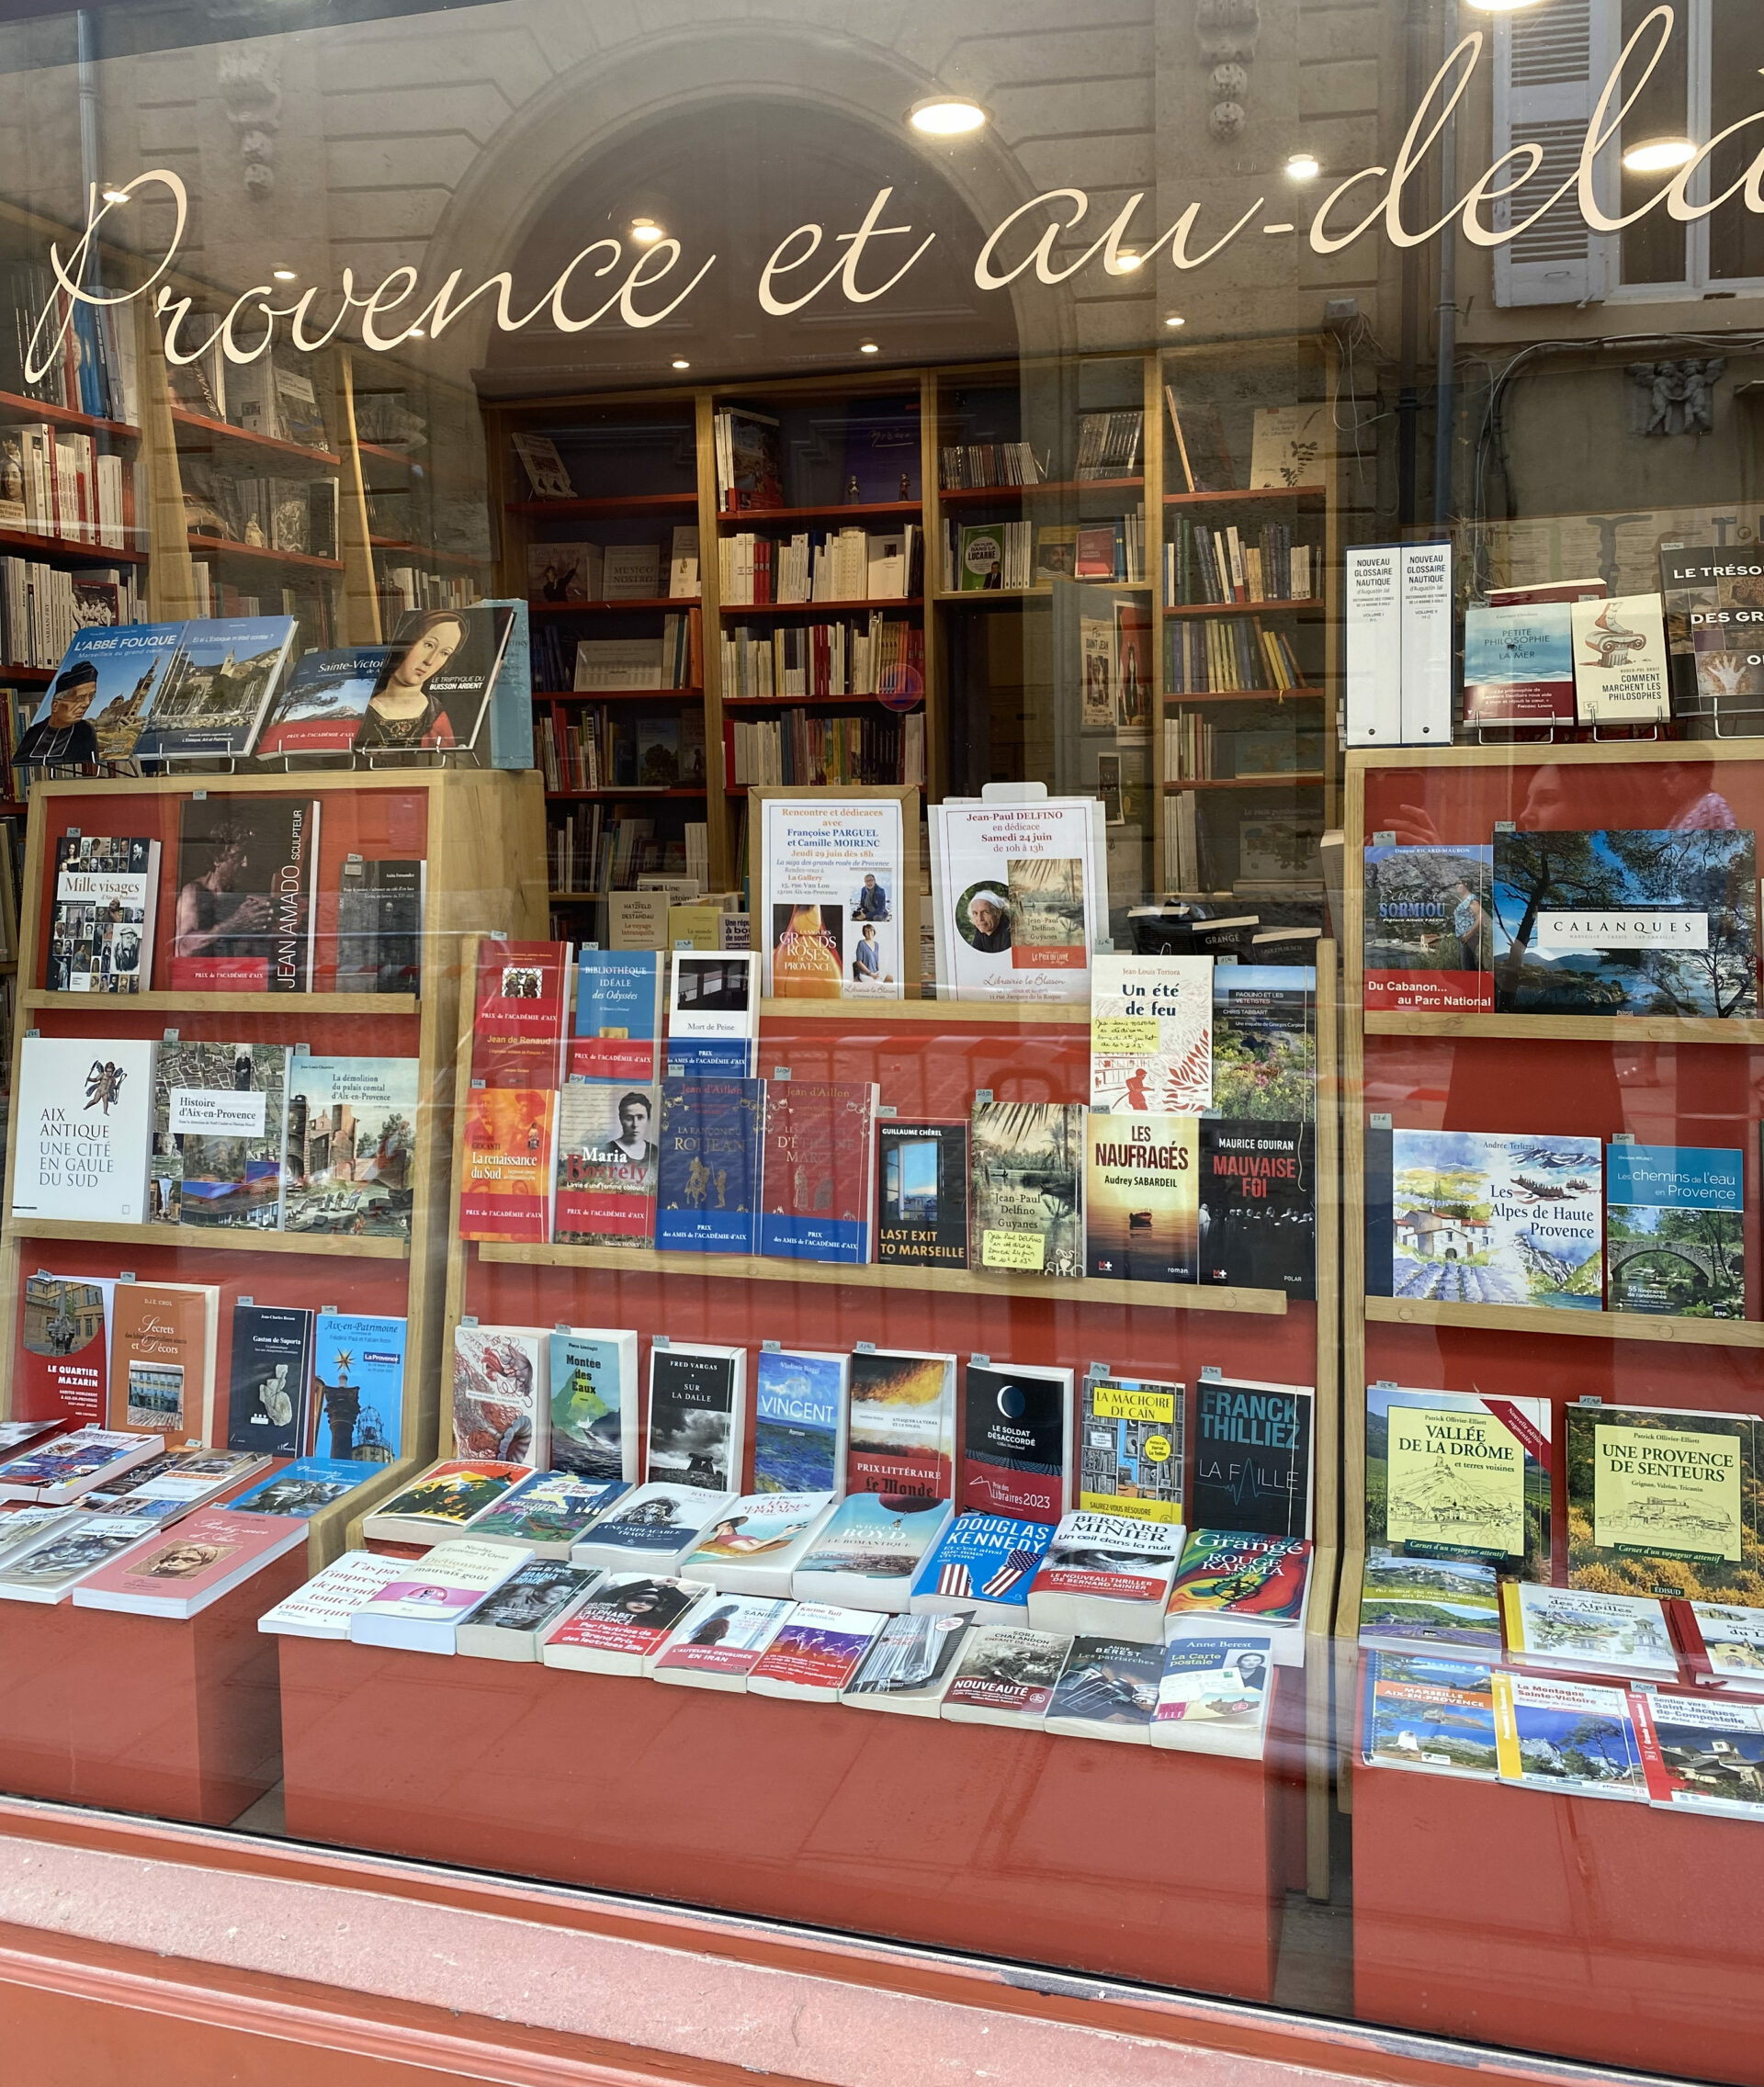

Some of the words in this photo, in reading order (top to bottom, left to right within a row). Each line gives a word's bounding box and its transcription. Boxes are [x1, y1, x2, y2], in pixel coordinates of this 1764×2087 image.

[24, 168, 717, 384] Provence
[757, 189, 935, 317] et
[1409, 555, 1443, 563] NOUVEAU
[1354, 568, 1392, 576] GLOSSAIRE
[1408, 565, 1445, 573] GLOSSAIRE
[1674, 568, 1696, 579] LE
[1701, 564, 1764, 577] TRÉSO
[1356, 578, 1391, 586] NAUTIQUE
[1409, 575, 1443, 583] NAUTIQUE
[1691, 612, 1730, 625] DES
[1502, 628, 1532, 637] PETITE
[74, 637, 119, 651] L'ABBÉ
[120, 635, 176, 648] FOUQUE
[1485, 635, 1550, 645] PHILOSOPHIE
[1622, 673, 1659, 683] COMMENT
[1602, 683, 1645, 693] MARCHENT
[1647, 683, 1661, 691] LES
[1609, 692, 1661, 701] PHILOSOPHES
[967, 812, 1014, 822] Jean-Paul
[1016, 812, 1063, 820] DELFINO
[291, 810, 302, 860] SCULPTEUR
[787, 829, 831, 838] Françoise
[981, 834, 1016, 842] Samedi
[1033, 833, 1052, 843] juin
[279, 865, 300, 937] AMADO
[1380, 901, 1445, 919] SORMIOU
[1554, 921, 1691, 934] CALANQUES
[277, 942, 296, 988] JEAN
[585, 966, 647, 977] BIBLIOTHÈQUE
[600, 978, 631, 987] IDÉALE
[1368, 982, 1384, 991] Du
[1386, 981, 1447, 993] Cabanon...
[593, 991, 604, 999] des
[606, 991, 638, 1002] Odyssées
[1123, 985, 1145, 996] Un
[1153, 983, 1180, 998] été
[1397, 997, 1413, 1005] au
[1416, 995, 1440, 1006] Parc
[1443, 995, 1491, 1007] National
[1125, 1001, 1144, 1016] de
[1152, 1001, 1176, 1016] feu
[687, 1022, 707, 1031] Mort
[179, 1097, 215, 1108] Histoire
[40, 1109, 65, 1122] AIX
[40, 1123, 109, 1140] ANTIQUE
[1132, 1125, 1151, 1142] LES
[40, 1143, 71, 1156] UNE
[76, 1141, 110, 1157] CITÉ
[1219, 1138, 1255, 1149] MAURICE
[1258, 1139, 1294, 1150] GOUIRAN
[472, 1152, 482, 1164] La
[484, 1154, 537, 1166] renaissance
[583, 1147, 628, 1163] Maria
[1095, 1141, 1188, 1170] NAUFRAGÉS
[40, 1157, 64, 1170] EN
[68, 1158, 113, 1172] GAULE
[1214, 1156, 1295, 1179] MAUVAISE
[40, 1173, 62, 1185] DU
[67, 1174, 98, 1187] SUD
[471, 1168, 482, 1179] du
[484, 1168, 501, 1179] Sud
[1104, 1175, 1132, 1187] Audrey
[1134, 1177, 1177, 1188] SABARDEIL
[1242, 1178, 1266, 1198] FOI
[994, 1193, 1041, 1204] Jean-Paul
[1490, 1184, 1513, 1199] Les
[1656, 1189, 1666, 1197] en
[1668, 1185, 1736, 1200] Provence
[1001, 1204, 1035, 1215] Delfino
[1491, 1203, 1529, 1219] Alpes
[1532, 1207, 1550, 1219] de
[1554, 1208, 1594, 1222] Haute
[881, 1230, 908, 1240] LAST
[911, 1230, 937, 1242] EXIT
[1531, 1223, 1595, 1239] Provence
[881, 1244, 896, 1255] TO
[899, 1245, 965, 1258] MARSEILLE
[138, 1315, 175, 1334] Secrets
[325, 1321, 398, 1333] Aix-en-Patrimoine
[253, 1336, 270, 1344] Gaston
[566, 1354, 601, 1370] Montée
[691, 1362, 718, 1371] VARGAS
[59, 1365, 98, 1377] QUARTIER
[574, 1369, 593, 1381] des
[58, 1377, 98, 1387] MAZARIN
[572, 1382, 596, 1394] Eaux
[684, 1383, 700, 1392] SUR
[673, 1392, 683, 1400] LA
[685, 1393, 712, 1403] DALLE
[1096, 1392, 1109, 1402] LA
[1112, 1392, 1170, 1408] MÂCHOIRE
[761, 1395, 833, 1423] VINCENT
[1111, 1406, 1126, 1417] DE
[1129, 1406, 1155, 1419] CAÏN
[1204, 1390, 1301, 1423] FRANCK
[988, 1432, 1036, 1446] DÉSACCORDÉ
[1002, 1427, 1030, 1437] SOLDAT
[1201, 1414, 1299, 1450] THILLIEZ
[1426, 1425, 1485, 1442] VALLÉE
[1399, 1438, 1421, 1450] DE
[1426, 1440, 1445, 1453] LA
[1451, 1443, 1514, 1461] DRÔME
[1602, 1444, 1637, 1459] UNE
[1643, 1448, 1734, 1468] PROVENCE
[857, 1463, 879, 1473] PRIX
[881, 1466, 941, 1480] LITTÉRAIRE
[1611, 1460, 1634, 1473] DE
[1638, 1463, 1724, 1482] SENTEURS
[865, 1477, 878, 1491] Le
[882, 1478, 933, 1497] Monde
[992, 1490, 1023, 1505] Libraires
[1023, 1494, 1050, 1508] 2023
[956, 1517, 1049, 1540] DOUGLAS
[1075, 1516, 1168, 1533] BERNARD
[1070, 1522, 1165, 1542] MINIER
[946, 1532, 1047, 1552] KENNEDY
[1195, 1534, 1303, 1555] Grangé
[1208, 1553, 1282, 1567] ROUGE
[1201, 1561, 1284, 1576] KARMA
[1068, 1579, 1105, 1587] BERNARD
[1108, 1582, 1147, 1590] MINIER
[1655, 1586, 1681, 1595] ÉDISUD
[704, 1654, 728, 1663] IRAN
[1095, 1648, 1141, 1657] BEREST
[1170, 1658, 1213, 1666] postale
[955, 1680, 1029, 1696] NOUVEAUTÉ
[1405, 1687, 1464, 1699] MARSEILLE
[1535, 1686, 1585, 1698] Montagne
[1385, 1690, 1485, 1708] AIX-EN-PROVENCE
[1517, 1690, 1597, 1704] Sainte-Victoire
